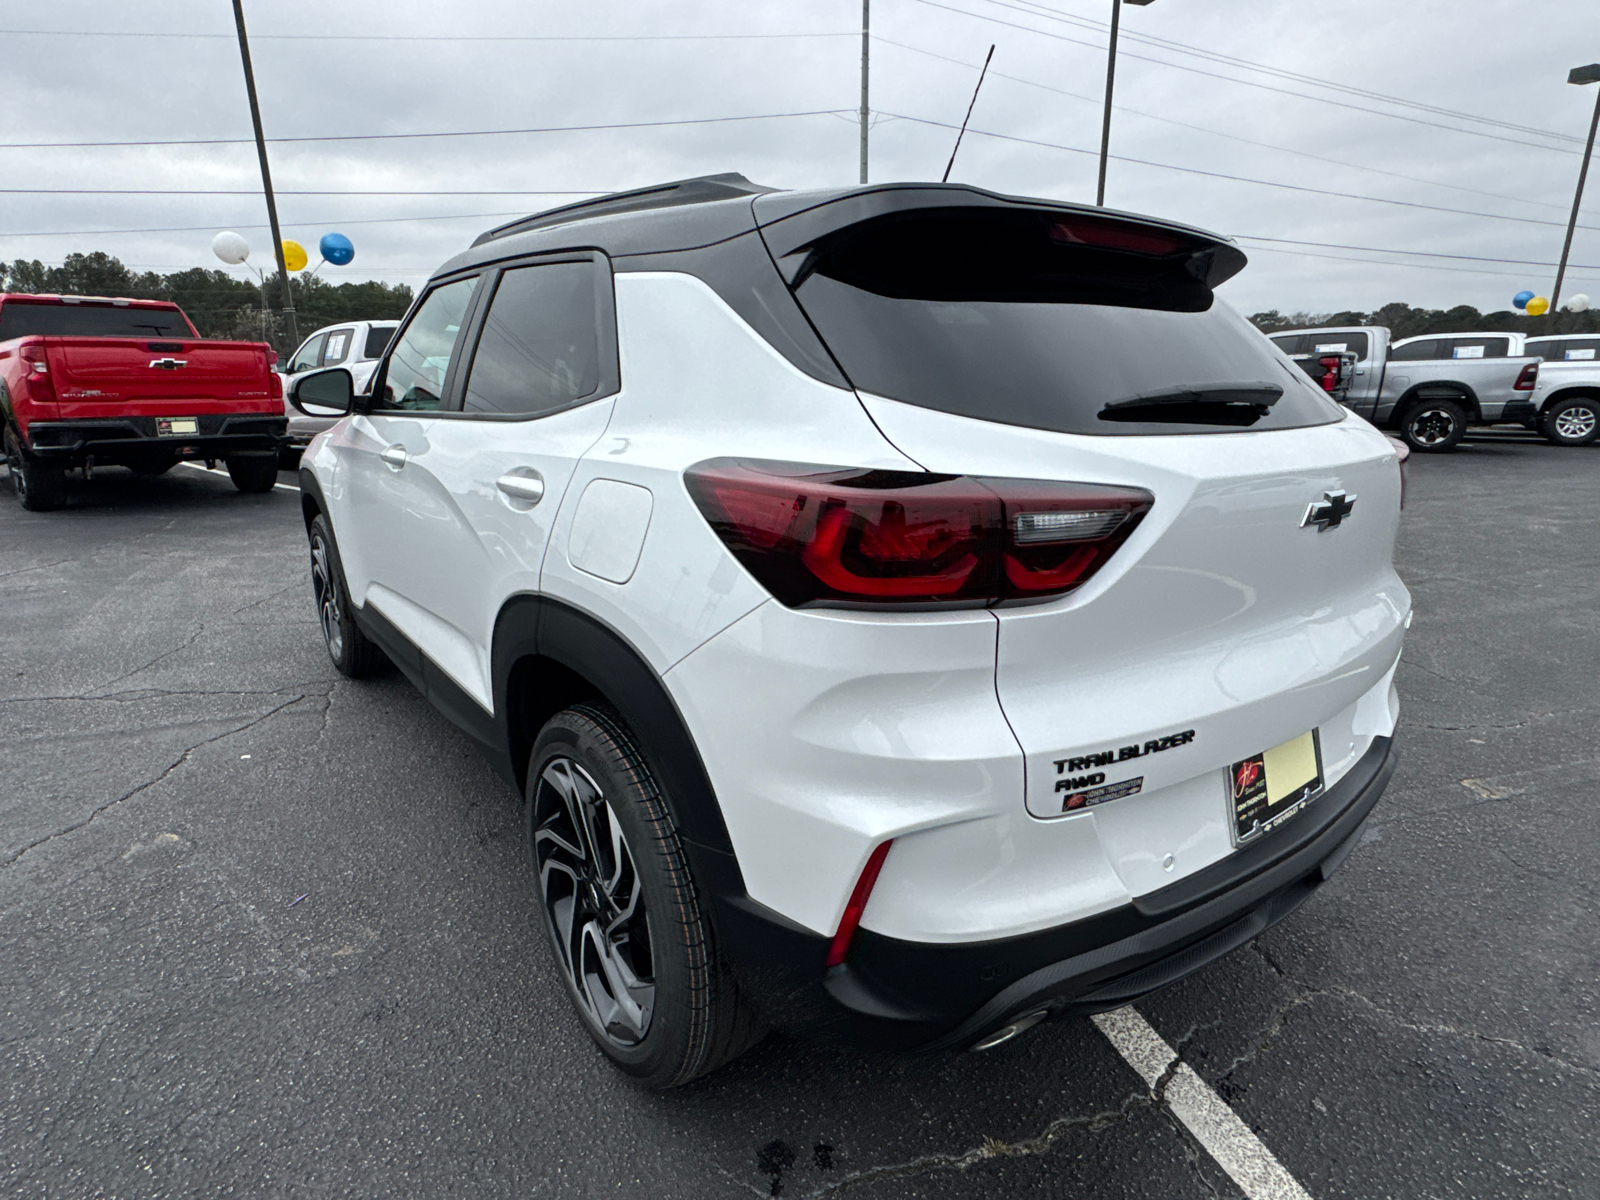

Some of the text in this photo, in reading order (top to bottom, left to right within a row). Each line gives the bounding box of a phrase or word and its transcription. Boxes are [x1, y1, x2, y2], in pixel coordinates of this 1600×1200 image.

[1053, 728, 1196, 774] TRAILBLAZER
[1055, 771, 1106, 793] AWD
[1087, 777, 1143, 800] JOHN THORNTON
[1086, 788, 1129, 806] CHEVROLET
[1273, 806, 1299, 827] CHEVROLET
